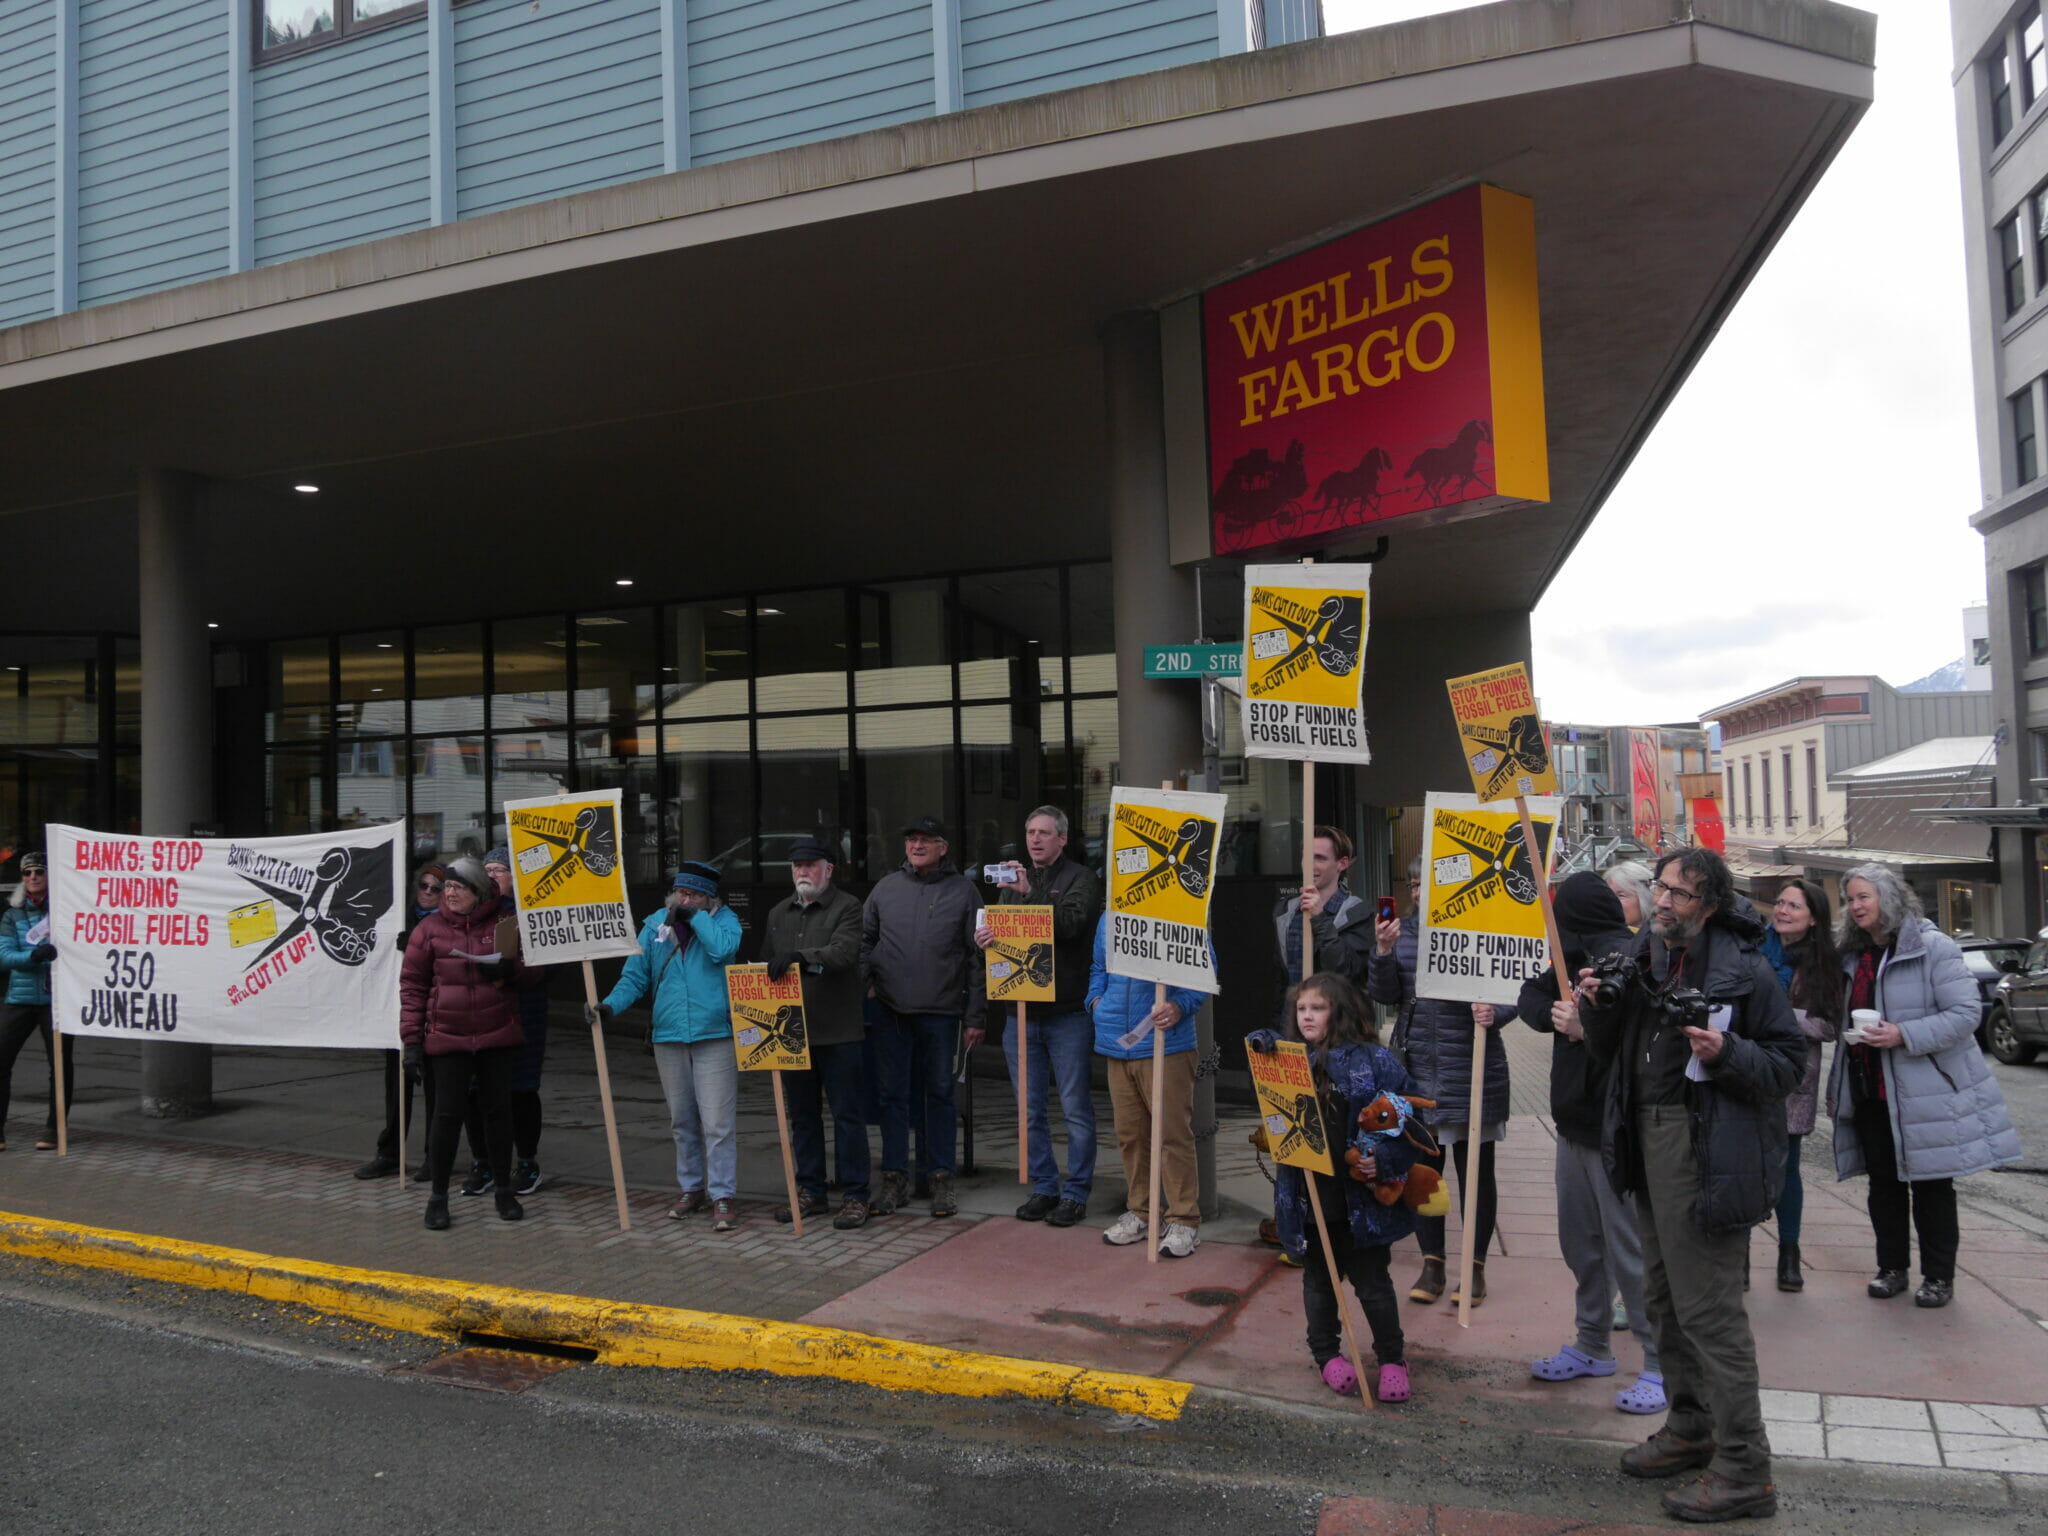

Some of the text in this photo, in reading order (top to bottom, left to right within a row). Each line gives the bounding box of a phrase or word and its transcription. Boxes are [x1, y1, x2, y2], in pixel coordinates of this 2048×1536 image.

[1229, 234, 1454, 360] WELLS
[1238, 311, 1456, 427] FARGO
[1273, 596, 1289, 616] CUT
[1287, 602, 1299, 619] IT
[1296, 606, 1317, 626] OUT
[1155, 652, 1191, 671] 2ND
[1265, 668, 1285, 690] CUT
[1285, 662, 1298, 680] IT
[1296, 651, 1315, 672] UP!
[1451, 674, 1527, 706] STOP FUNDING
[1250, 703, 1357, 727] STOP FUNDING
[1455, 691, 1531, 721] FOSSIL FUELS
[1250, 723, 1357, 748] FOSSIL FUELS
[1477, 726, 1488, 738] CUT
[1488, 728, 1495, 739] IT
[1496, 729, 1508, 742] OUT
[1488, 778, 1503, 795] CUT
[1499, 771, 1509, 785] IT
[532, 815, 547, 831] CUT
[547, 818, 557, 833] IT
[557, 821, 575, 837] OUT
[1136, 814, 1152, 833] CUT
[1149, 821, 1161, 838] IT
[1158, 826, 1177, 846] OUT
[1456, 819, 1475, 839] CUT
[1472, 825, 1486, 843] IT
[1483, 830, 1503, 851] OUT
[75, 840, 204, 872] BANKS: STOP
[253, 854, 278, 880] CUT
[275, 860, 292, 885] IT
[288, 866, 315, 893] OUT
[536, 879, 555, 899] CUT
[552, 871, 564, 887] IT
[561, 858, 582, 878] UP!
[1127, 885, 1145, 905] CUT
[1145, 879, 1157, 896] IT
[1156, 870, 1176, 890] UP!
[95, 877, 179, 908] FUNDING
[1446, 895, 1467, 918] CUT
[1467, 888, 1479, 907] IT
[1479, 877, 1502, 899] UP!
[73, 912, 209, 946] FOSSIL FUELS
[527, 902, 625, 930] STOP FUNDING
[986, 914, 1052, 926] STOP FUNDING
[1114, 915, 1148, 938] STOP
[529, 921, 627, 949] FOSSIL FUELS
[1023, 926, 1051, 938] FUELS
[1430, 931, 1544, 959] STOP FUNDING
[245, 962, 272, 995] CUT
[271, 950, 288, 977] IT
[286, 931, 316, 964] UP!
[1114, 935, 1209, 969] FOSSIL FUELS
[104, 949, 155, 990] 350
[1428, 953, 1541, 980] FOSSIL FUELS
[227, 984, 239, 997] OR
[729, 974, 754, 988] STOP
[730, 986, 800, 1001] FOSSIL FUELS
[81, 989, 177, 1032] JUNEAU
[747, 1007, 757, 1019] CUT
[764, 1011, 776, 1025] OUT
[750, 1052, 763, 1065] CUT
[761, 1047, 769, 1058] IT
[1272, 1052, 1308, 1071] FUNDING
[1253, 1065, 1312, 1088] FOSSIL FUELS
